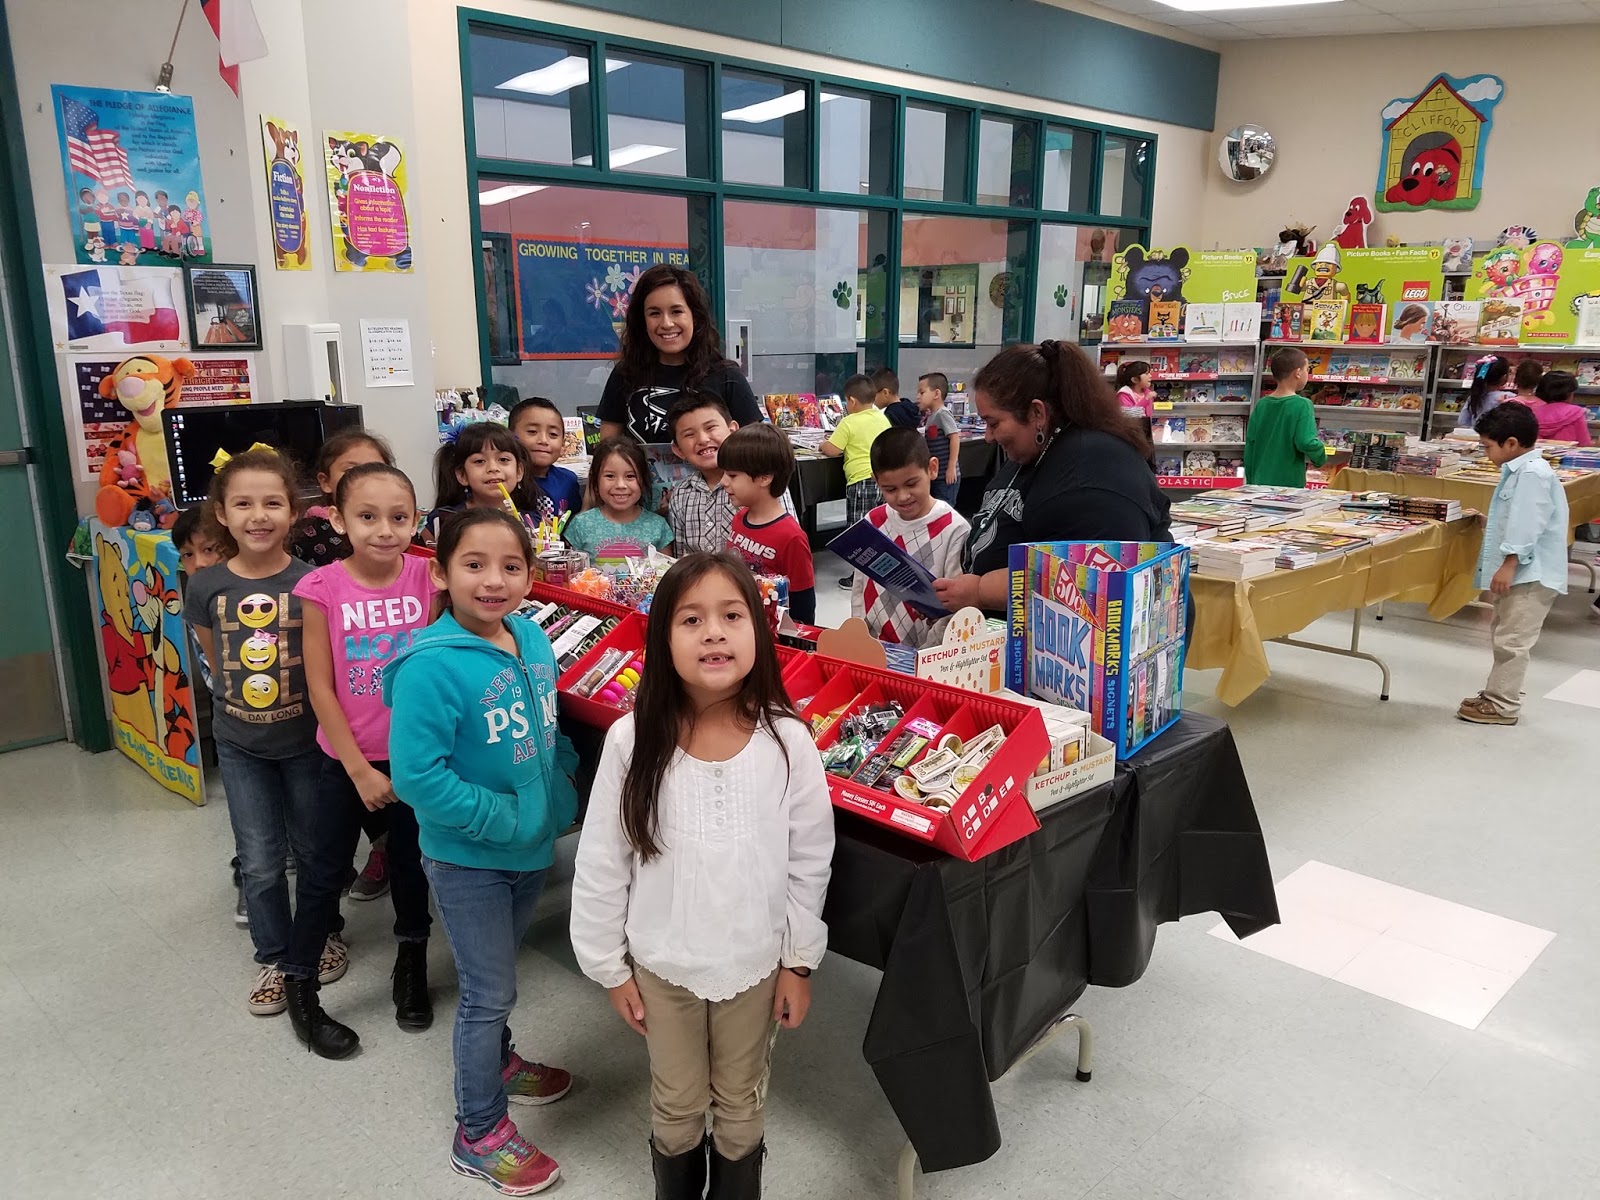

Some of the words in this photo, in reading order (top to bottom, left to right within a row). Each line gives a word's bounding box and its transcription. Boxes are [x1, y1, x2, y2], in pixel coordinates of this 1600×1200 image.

[90, 100, 102, 108] THE
[105, 101, 133, 110] PLEDGE
[148, 104, 191, 115] ALLEGIANCE
[1403, 115, 1466, 138] CLIFFORD
[273, 171, 293, 184] Fiction
[353, 184, 396, 194] Nonfiction
[518, 243, 578, 260] GROWING
[585, 248, 647, 264] TOGETHER
[653, 252, 664, 264] IN
[669, 252, 689, 265] REA
[1405, 288, 1427, 298] LEGO
[1454, 303, 1471, 311] Otis
[1158, 478, 1211, 486] OLASTIC
[733, 533, 776, 560] PAWS
[341, 595, 422, 631] NEED
[1011, 570, 1024, 637] BOOKMARKS
[1032, 598, 1091, 672] BOOK
[1105, 600, 1122, 676] BOOKMARKS
[921, 648, 959, 665] KETCHUP
[961, 646, 967, 654] &
[969, 636, 1005, 652] MUSTARD
[940, 664, 949, 672] Pen
[955, 656, 979, 671] Highlighter
[1013, 640, 1022, 684] SIGNETS
[479, 667, 517, 710] NEW
[511, 686, 522, 699] 19
[537, 682, 545, 694] 87
[1034, 655, 1086, 711] MARKS
[249, 713, 268, 722] DAY
[271, 705, 300, 720] LONG
[1105, 680, 1115, 729] SIGNETS
[483, 701, 529, 744] PS
[513, 736, 537, 765] AE
[1035, 771, 1070, 790] KETCHUP
[1072, 768, 1077, 776] &
[1080, 754, 1113, 772] MUSTARD
[841, 789, 854, 800] Money
[854, 794, 869, 805] Erasers
[876, 802, 886, 811] Each
[978, 792, 986, 806] B
[999, 784, 1008, 799] E
[962, 814, 970, 829] A
[982, 805, 991, 819] D
[966, 826, 974, 839] C
